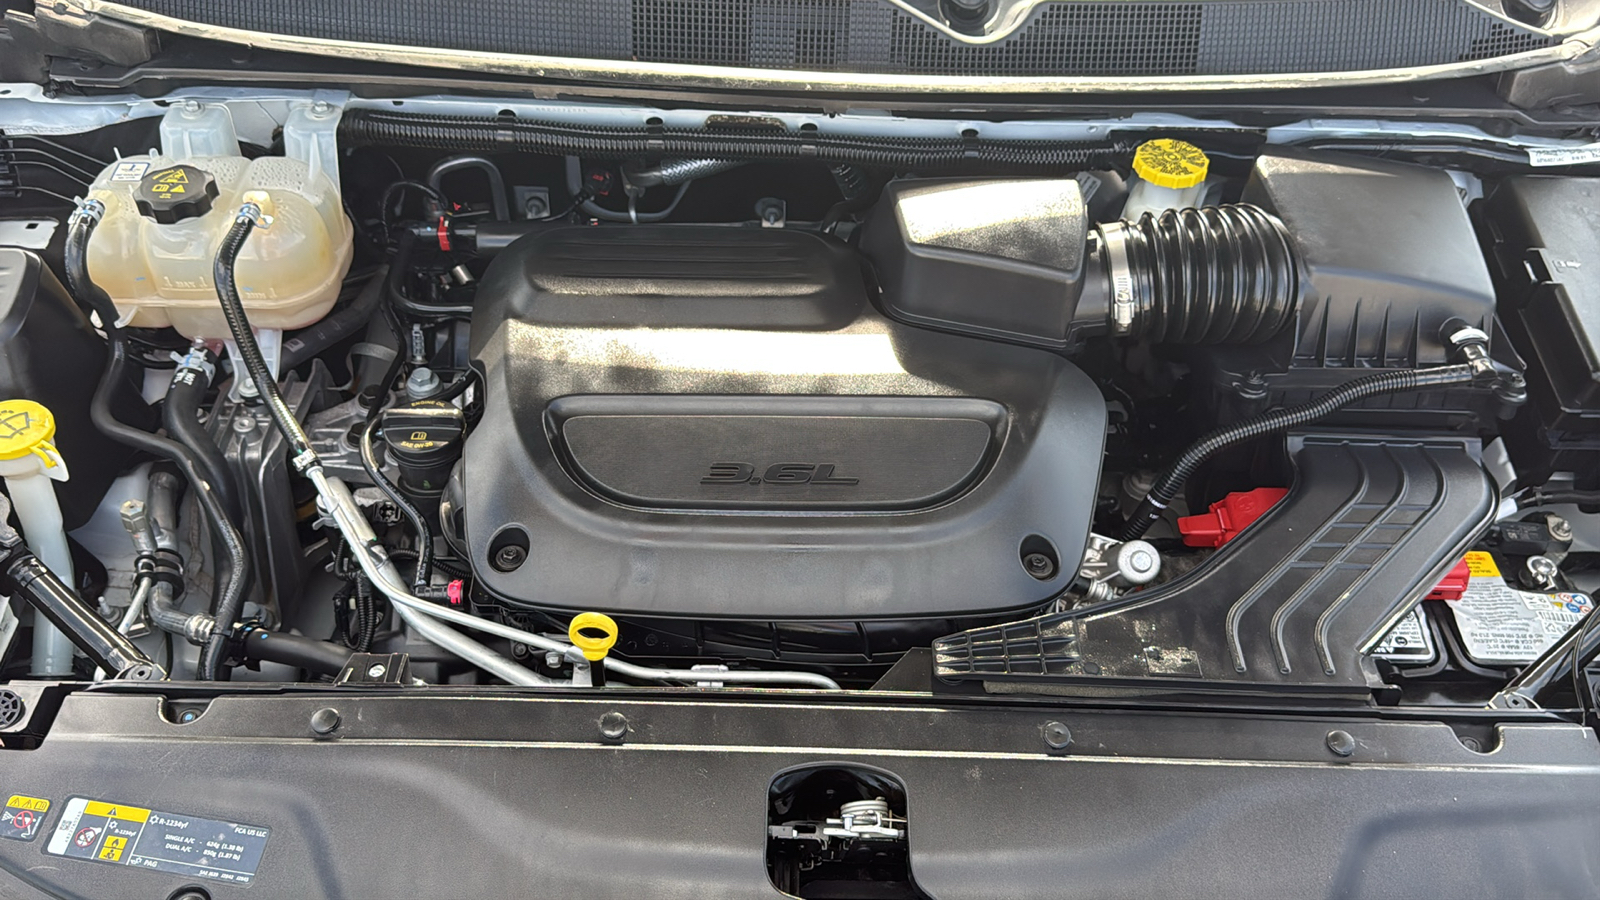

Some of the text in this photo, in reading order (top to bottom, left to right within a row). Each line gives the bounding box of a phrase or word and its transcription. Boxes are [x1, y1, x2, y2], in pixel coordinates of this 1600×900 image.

[436, 400, 446, 408] OIL
[414, 441, 434, 449] 0W-20
[700, 462, 859, 485] 3.6L
[158, 819, 189, 830] R-1234yf
[234, 827, 246, 835] FCA
[256, 830, 267, 838] LLC
[164, 834, 184, 843] SINGLE
[184, 836, 196, 844] A/C
[165, 843, 180, 851] DUAL
[180, 845, 193, 853] A/C
[143, 860, 158, 868] PAG
